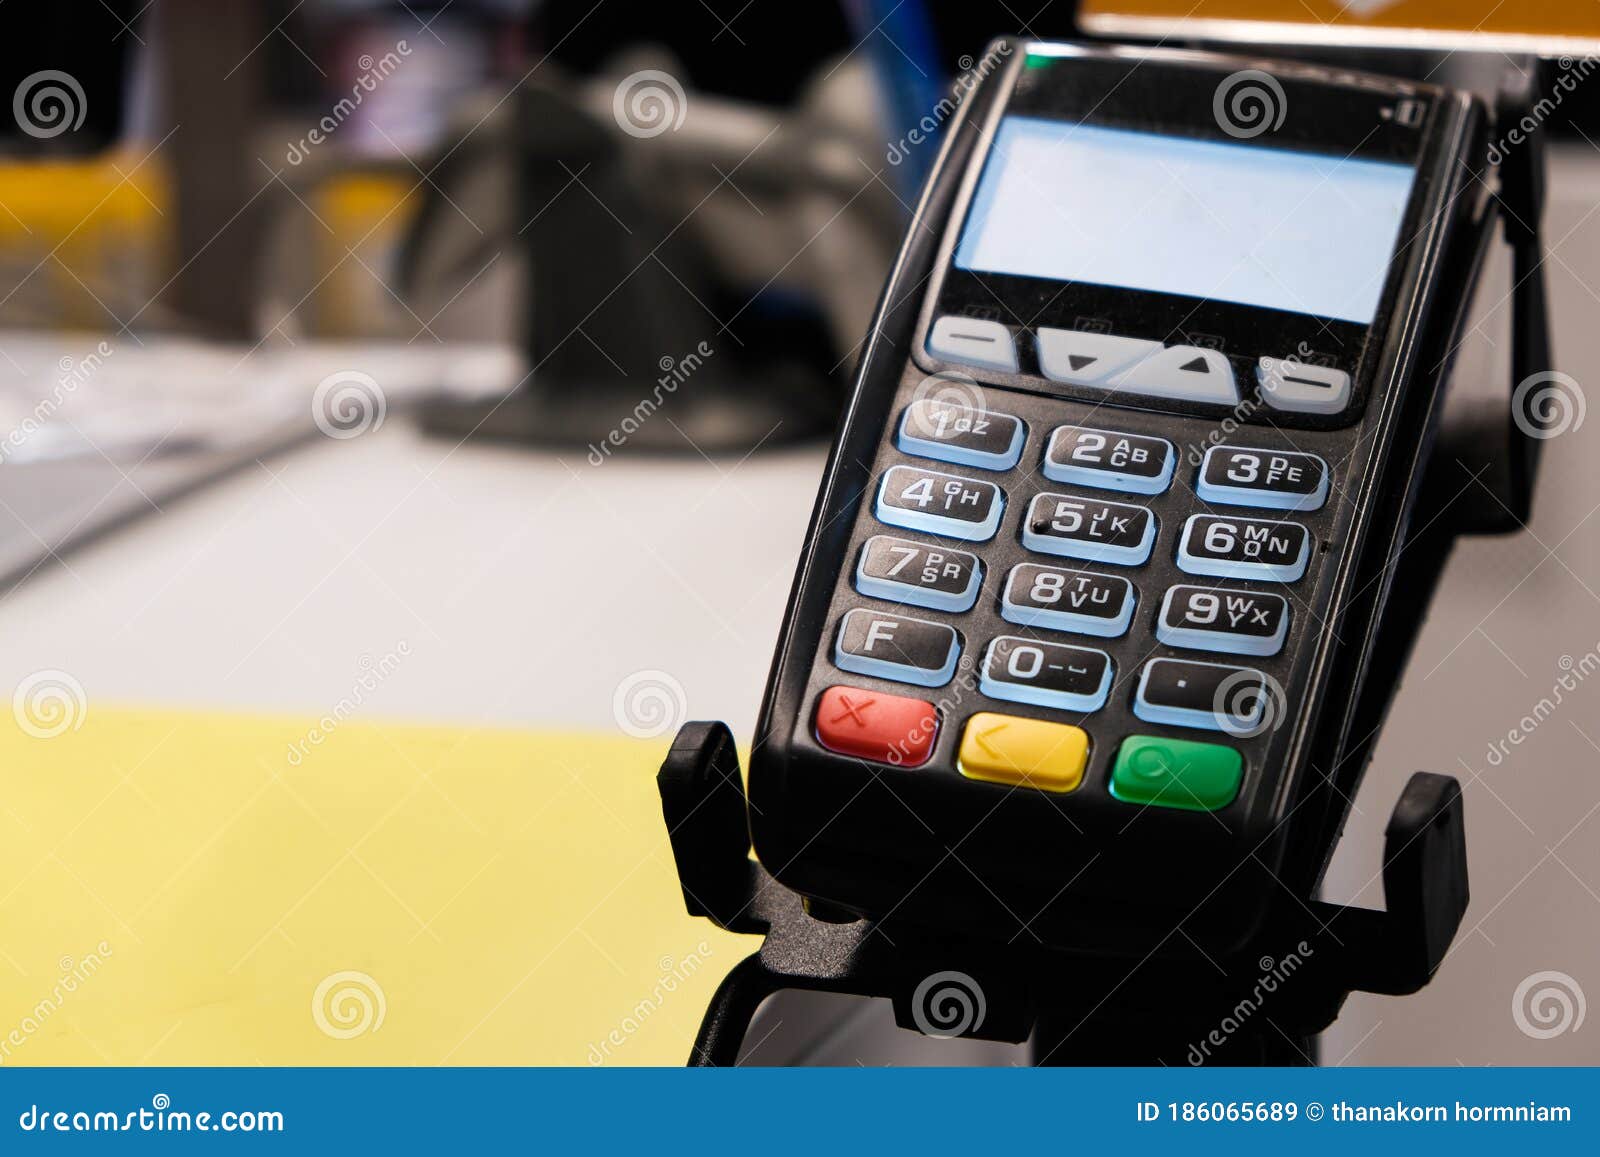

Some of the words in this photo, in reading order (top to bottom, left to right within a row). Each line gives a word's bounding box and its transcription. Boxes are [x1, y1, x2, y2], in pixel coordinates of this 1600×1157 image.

[1072, 434, 1106, 462] 2
[1227, 454, 1260, 482] 3
[901, 479, 934, 507] 4
[1051, 502, 1085, 531] 5
[1204, 522, 1238, 553] 6
[887, 546, 920, 575] 7
[1030, 573, 1065, 603] 8
[1185, 593, 1220, 623] 9
[863, 620, 899, 651] F
